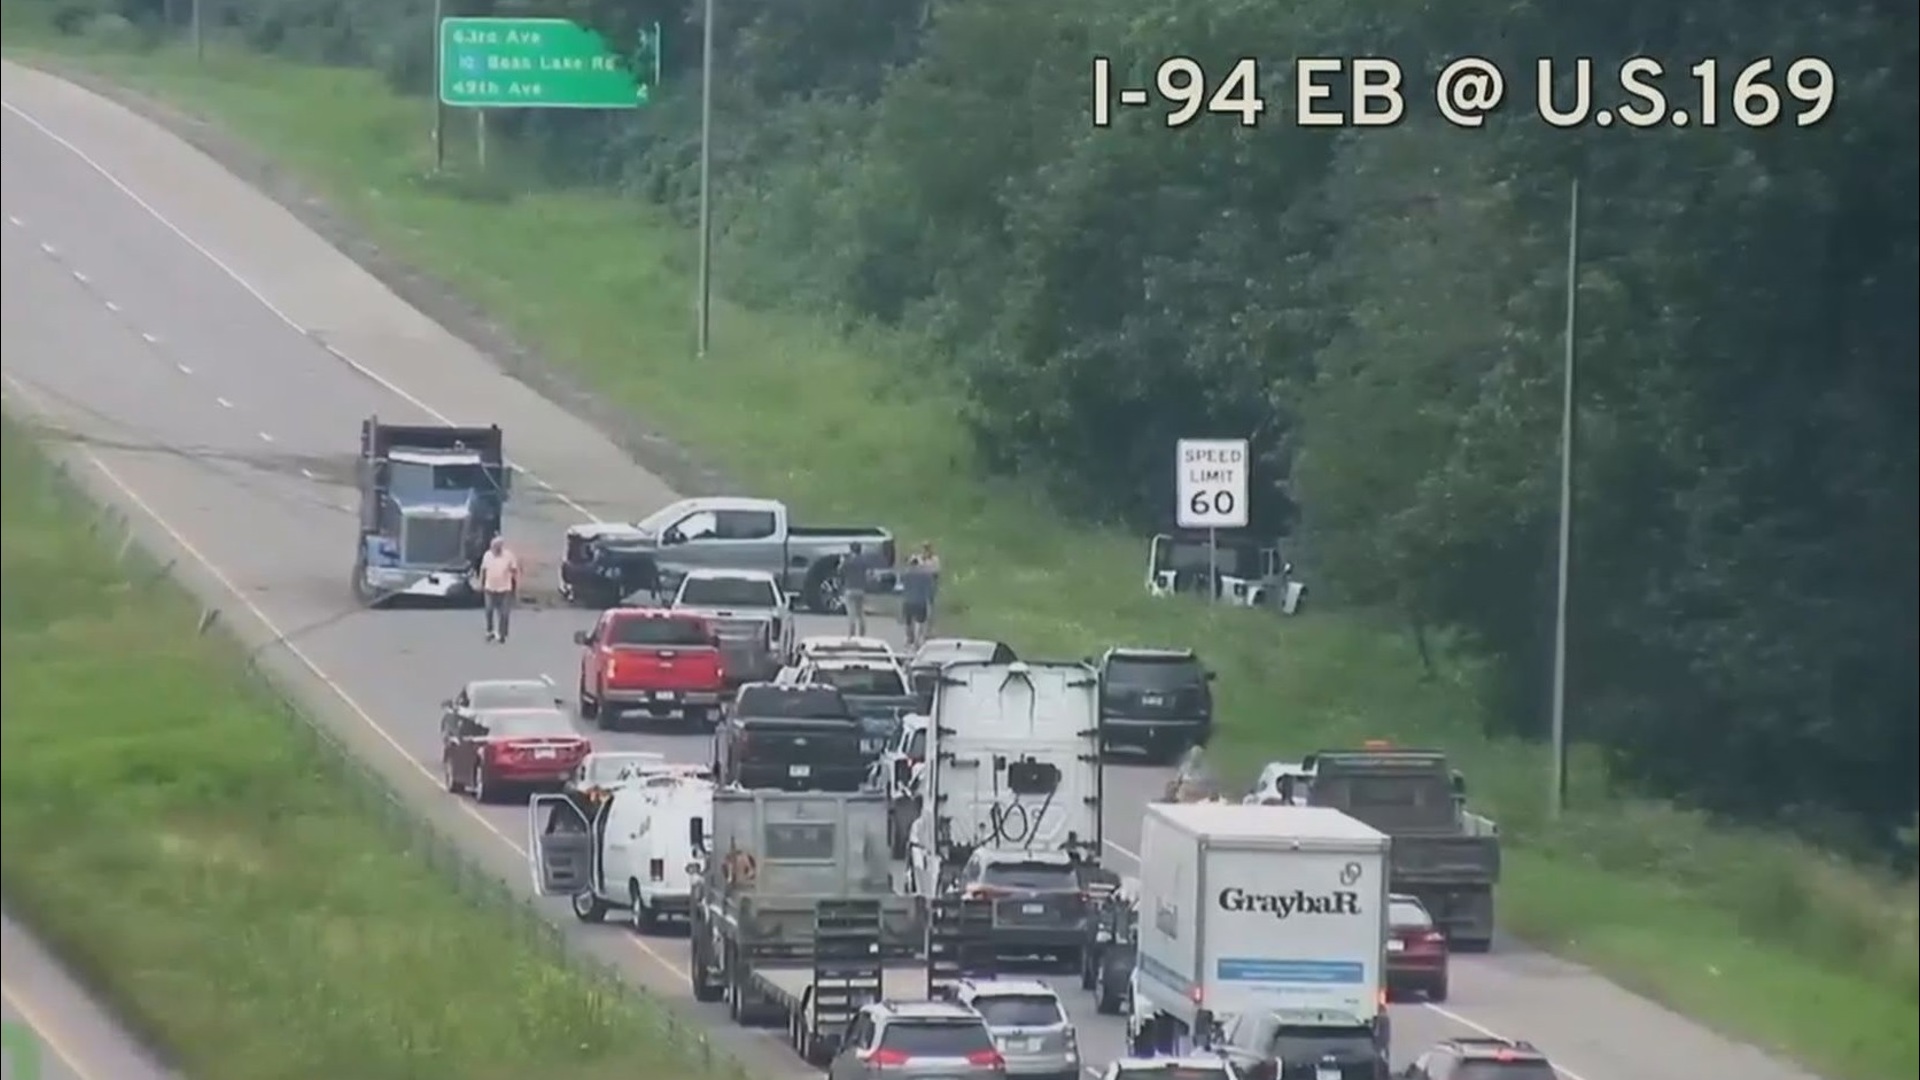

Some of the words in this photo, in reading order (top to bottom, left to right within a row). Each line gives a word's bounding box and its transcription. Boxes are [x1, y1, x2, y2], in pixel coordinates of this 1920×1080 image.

[506, 30, 541, 44] Ave
[540, 56, 582, 70] Lake
[508, 82, 542, 95] Ave
[1185, 449, 1241, 463] SPEED
[1190, 470, 1233, 483] LIMIT
[1190, 490, 1234, 515] 60
